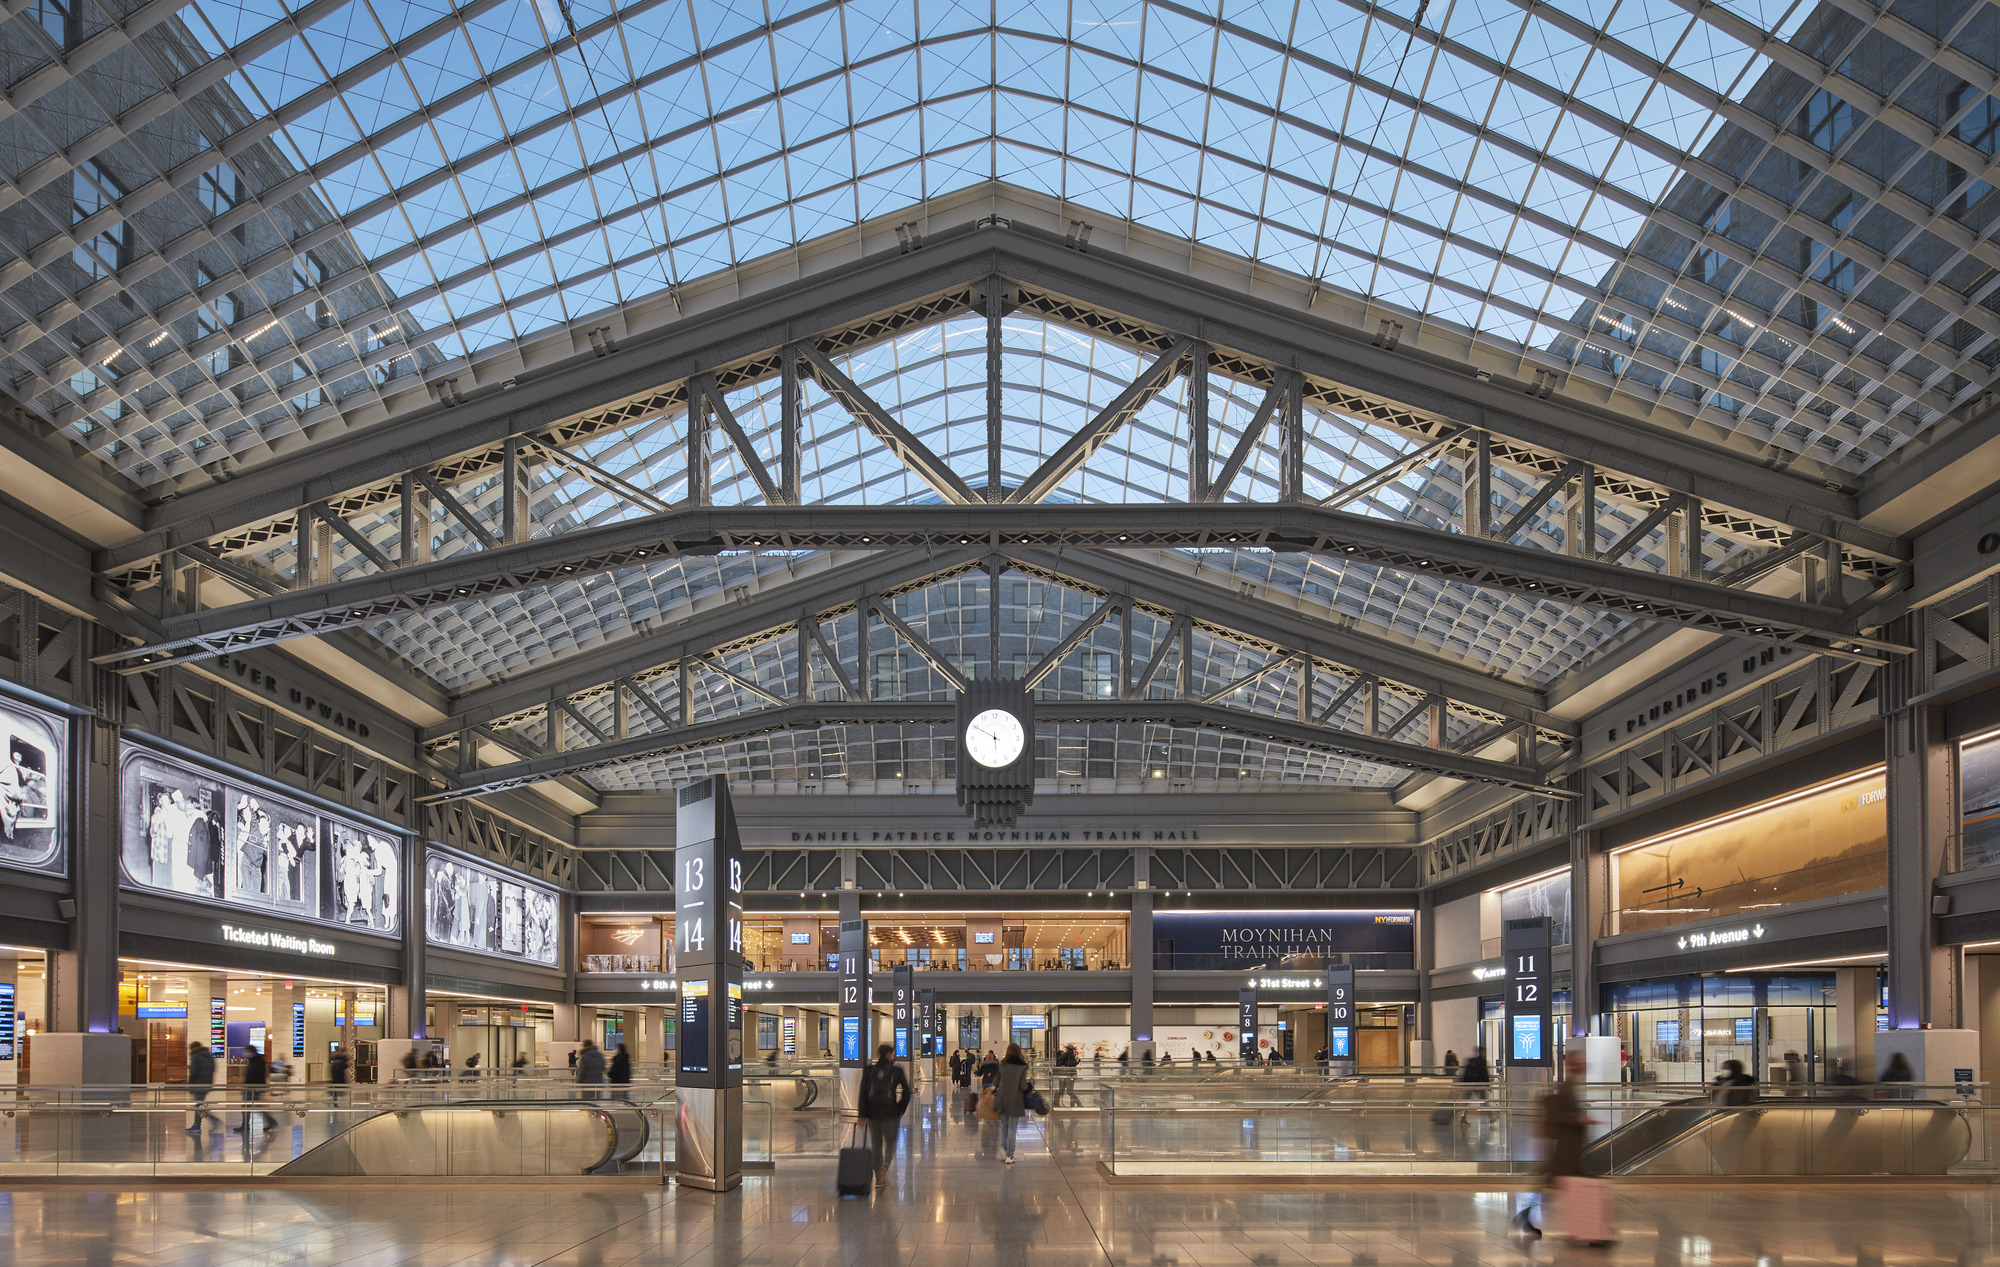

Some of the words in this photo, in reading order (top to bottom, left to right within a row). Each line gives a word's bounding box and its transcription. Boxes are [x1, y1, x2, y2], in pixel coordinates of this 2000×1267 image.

[218, 653, 277, 694] EVER
[290, 687, 370, 738] UPWARD
[1608, 728, 1616, 742] E
[1626, 672, 1727, 734] PLURIBUS
[1842, 795, 1858, 811] NY
[792, 832, 859, 842] DANIEL
[873, 832, 954, 841] PATRICK
[968, 832, 1070, 841] MOYNIHAN
[1083, 831, 1141, 840] TRAIN
[1154, 831, 1200, 840] HALL
[684, 857, 704, 893] 13
[730, 857, 742, 894] 13
[222, 925, 268, 946] Ticketed
[270, 932, 308, 954] Waiting
[308, 938, 335, 956] Room
[683, 917, 705, 953] 14
[730, 918, 742, 954] 14
[1222, 928, 1333, 942] MOYNIHAN
[1690, 933, 1707, 948] 9th
[1709, 929, 1749, 946] Avenue
[1220, 945, 1280, 959] TRAIN
[1287, 945, 1336, 959] HALL
[845, 957, 856, 975] 11
[1518, 955, 1536, 973] 11
[653, 980, 668, 990] 8th
[743, 980, 762, 990] reet
[1260, 978, 1280, 988] 31st
[1282, 978, 1310, 988] Street
[844, 986, 857, 1004] 12
[898, 989, 904, 1000] 9
[1336, 988, 1344, 1000] 9
[1516, 984, 1538, 1002] 12
[897, 1008, 906, 1020] 10
[924, 1006, 929, 1014] 7
[1244, 1004, 1250, 1014] 7
[1334, 1007, 1348, 1019] 10
[924, 1019, 929, 1028] 8
[1244, 1018, 1250, 1027] 8
